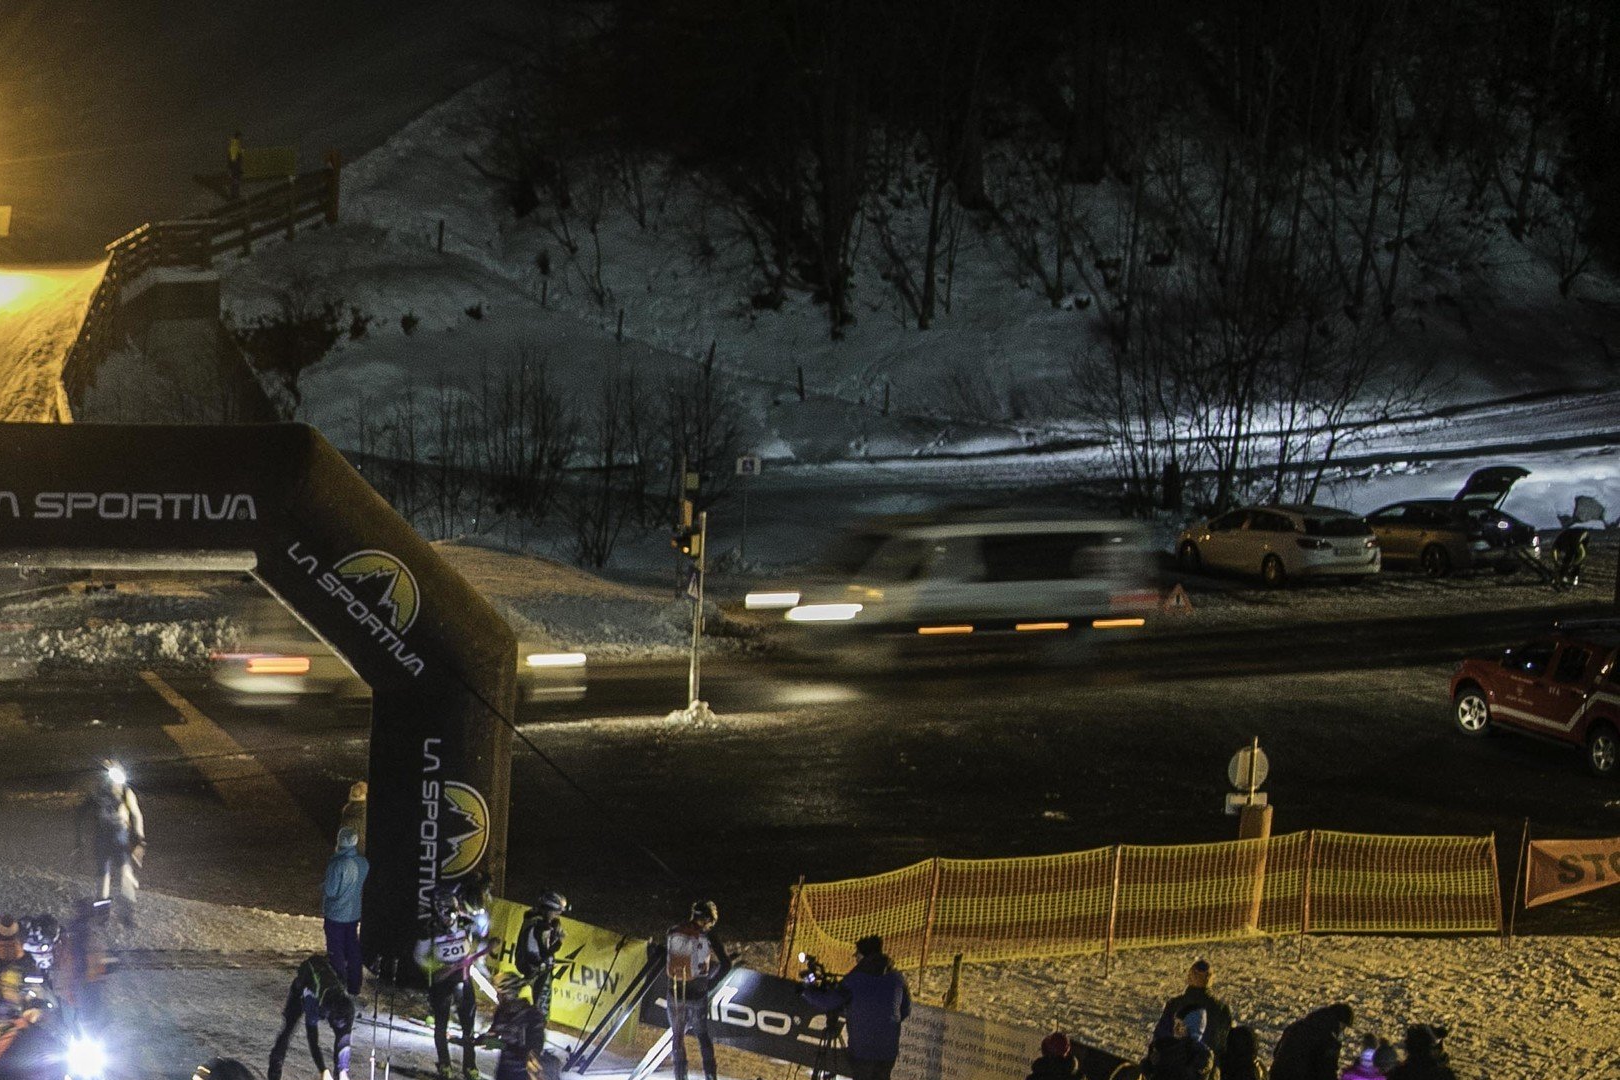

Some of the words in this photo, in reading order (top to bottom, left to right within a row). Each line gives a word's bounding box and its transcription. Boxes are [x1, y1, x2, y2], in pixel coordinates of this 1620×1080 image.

[34, 492, 257, 520] SPORTIVA
[288, 541, 319, 575] LA
[316, 572, 425, 677] SPORTIVA
[422, 738, 442, 773] LA
[418, 780, 440, 920] SPORTIVA
[442, 945, 465, 957] 201
